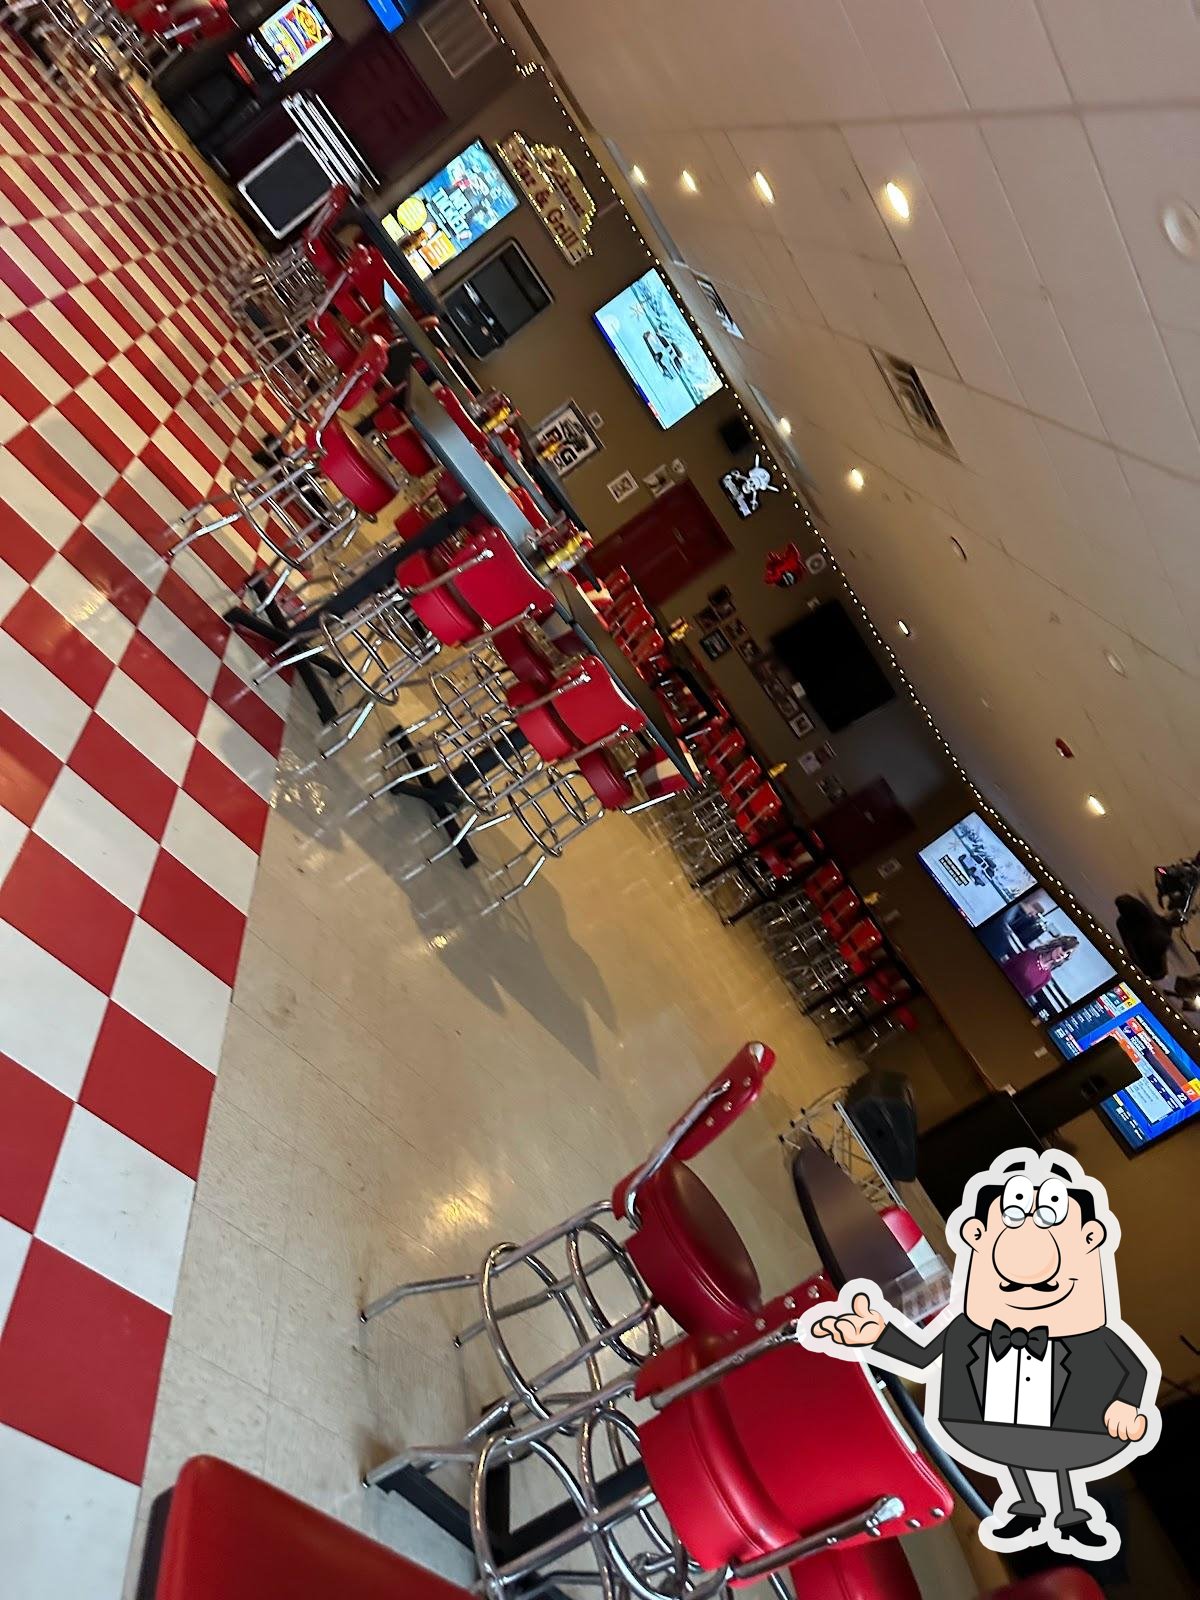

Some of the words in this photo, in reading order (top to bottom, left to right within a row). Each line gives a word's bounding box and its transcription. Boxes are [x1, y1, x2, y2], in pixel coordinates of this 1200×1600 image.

[430, 186, 469, 236] TICKET
[534, 188, 554, 208] &
[545, 206, 579, 248] Grill
[1176, 1091, 1188, 1102] 22
